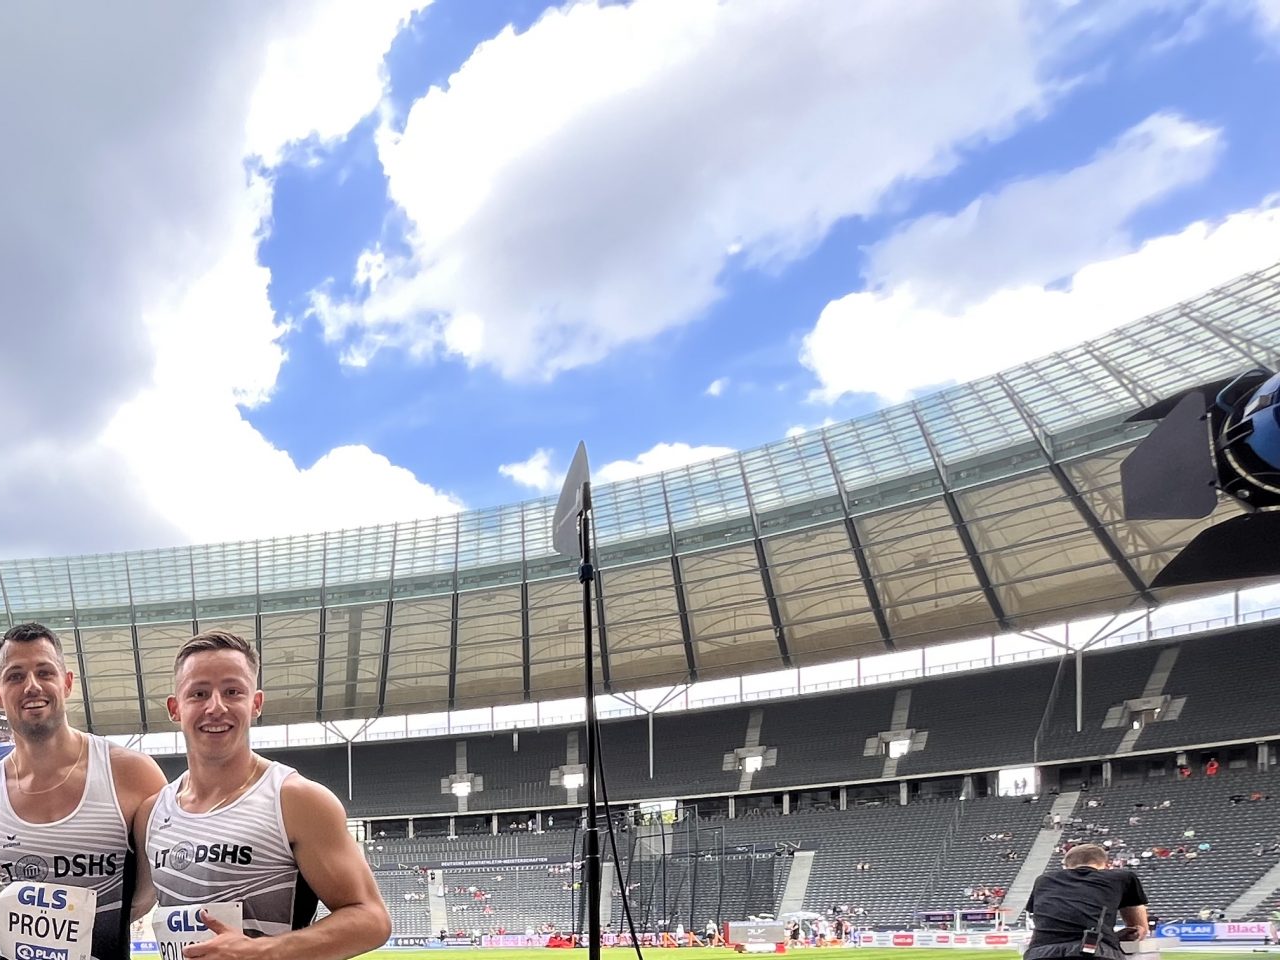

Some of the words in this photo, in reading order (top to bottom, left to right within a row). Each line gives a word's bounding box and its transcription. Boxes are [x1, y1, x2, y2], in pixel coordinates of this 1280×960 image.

[54, 853, 117, 878] DSHS
[155, 849, 170, 869] LT
[195, 844, 252, 865] DSHS
[9, 910, 80, 943] PRÖVE
[1180, 926, 1211, 934] PLAN
[1227, 924, 1266, 934] Black
[35, 949, 66, 960] PLAN
